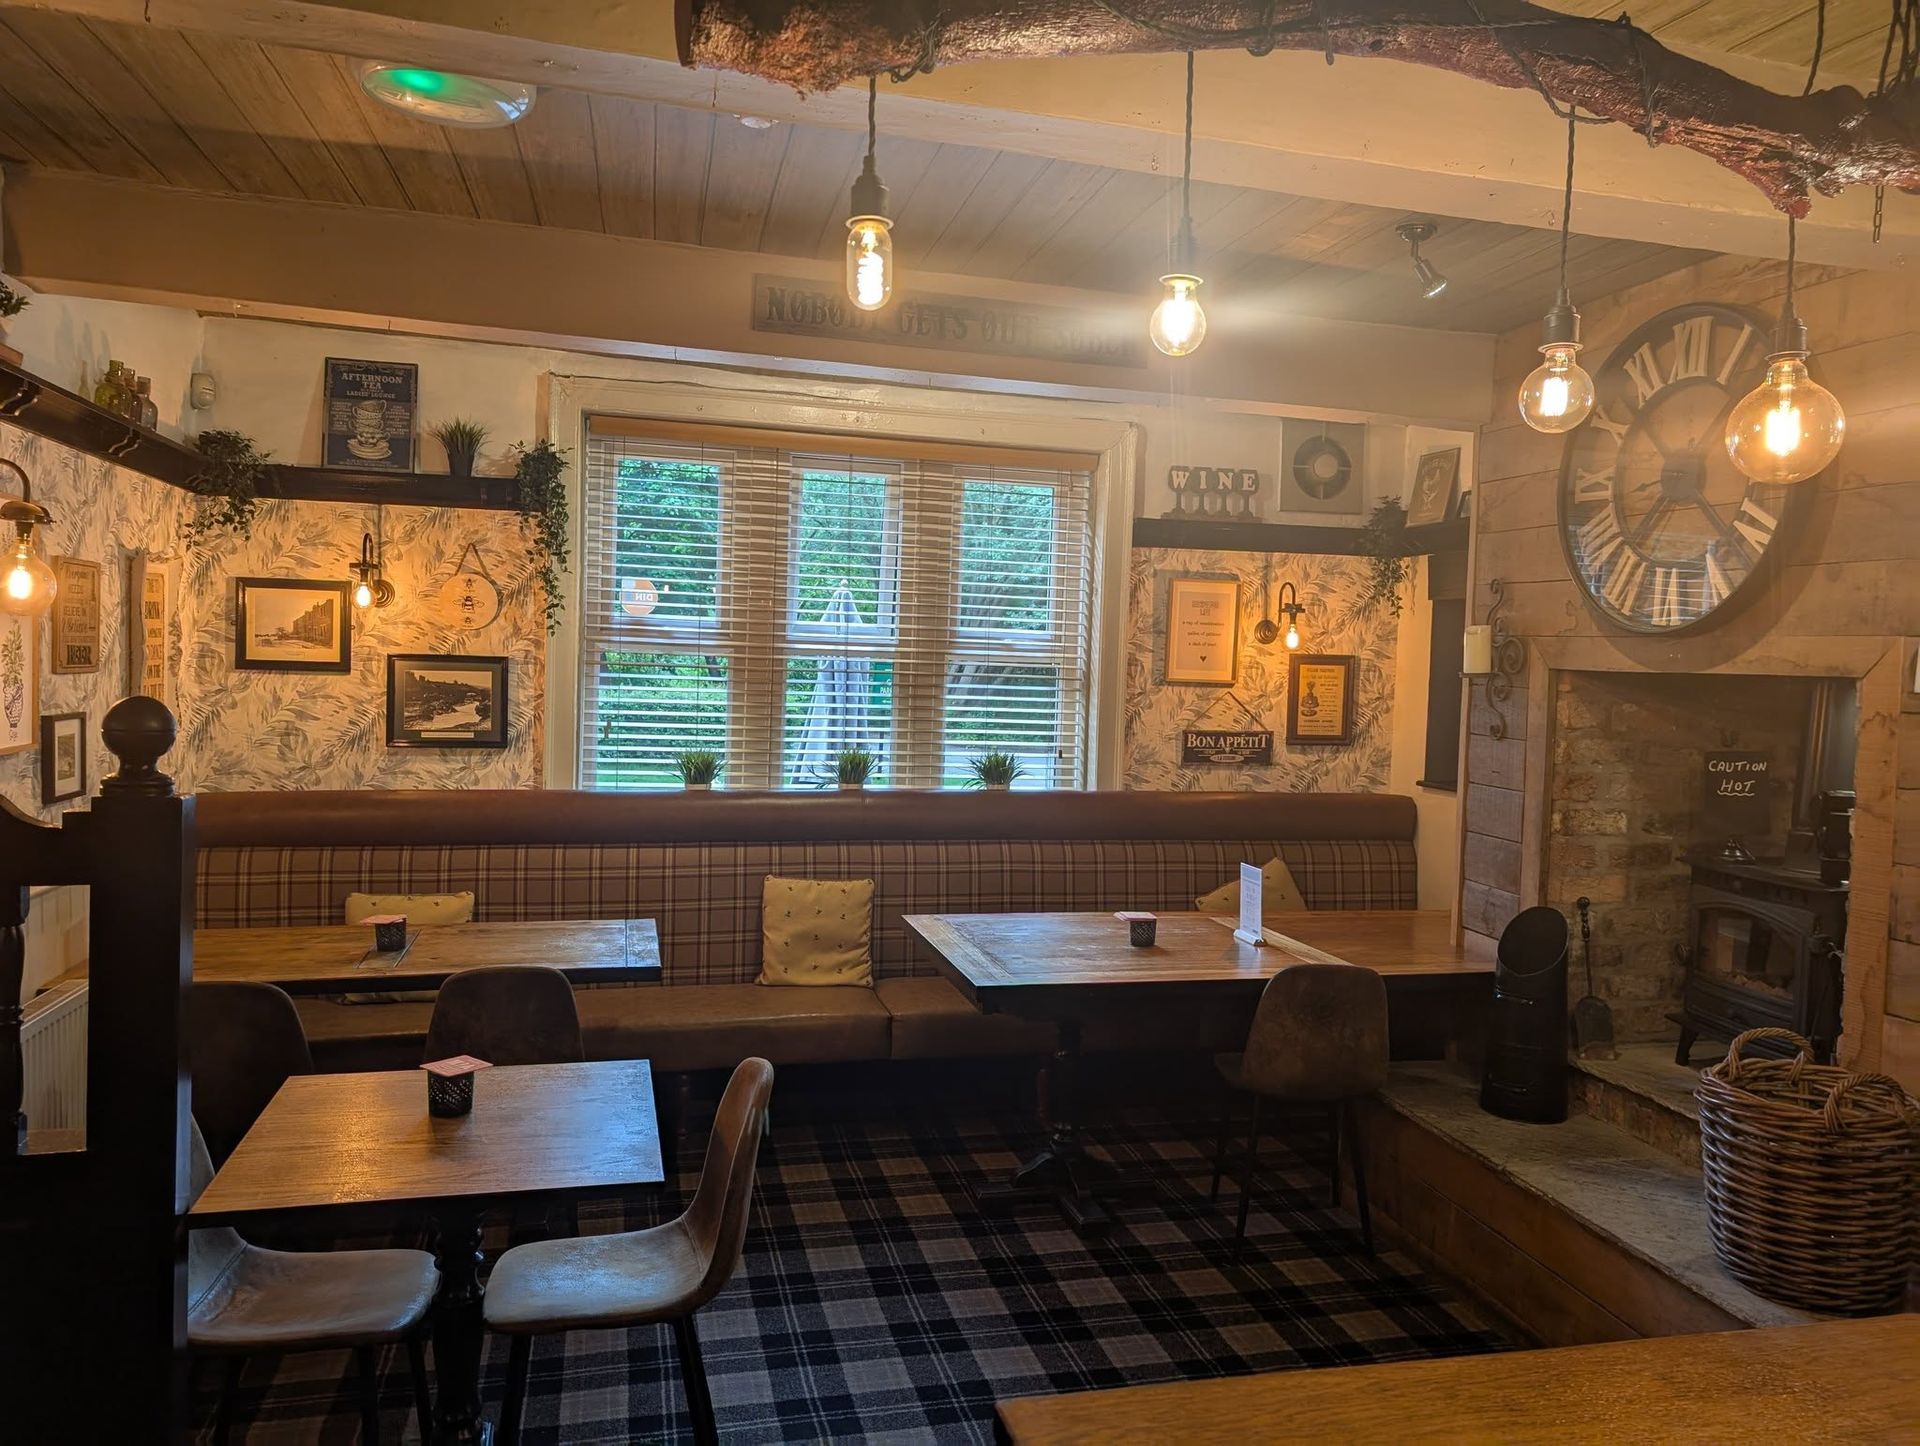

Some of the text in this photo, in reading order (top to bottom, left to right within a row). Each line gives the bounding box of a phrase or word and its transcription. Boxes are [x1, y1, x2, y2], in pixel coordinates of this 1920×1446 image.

[899, 302, 968, 341] GETS
[981, 311, 1039, 348] OUT
[341, 372, 403, 384] AFTERNOON
[362, 381, 382, 390] TEA
[1171, 470, 1256, 491] WINE
[1187, 734, 1269, 750] BON APPÉTIT
[1708, 760, 1767, 773] CAUTION
[1720, 779, 1756, 792] HOT
